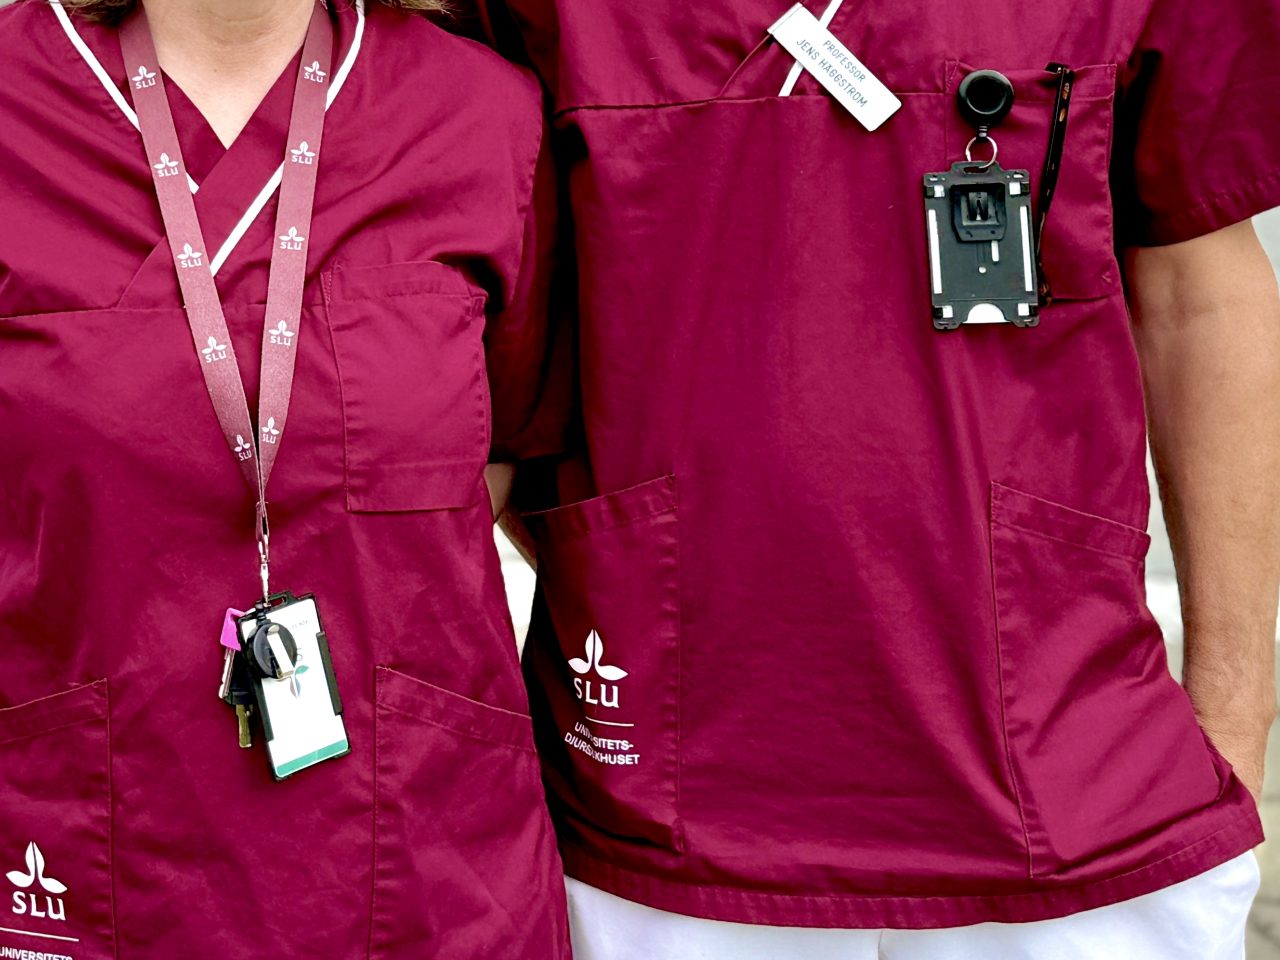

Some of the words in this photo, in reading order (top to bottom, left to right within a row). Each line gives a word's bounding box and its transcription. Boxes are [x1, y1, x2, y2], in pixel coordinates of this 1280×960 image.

[796, 39, 820, 60] JENS
[823, 40, 866, 83] PROFESSOR
[304, 71, 324, 83] SLU
[135, 78, 156, 89] SLU
[291, 154, 313, 165] SLU
[157, 167, 179, 178] SLU
[280, 241, 302, 251] SLU
[180, 258, 203, 269] SLU
[270, 335, 292, 347] SLU
[205, 350, 227, 363] SLU
[262, 433, 277, 445] SLU
[238, 450, 253, 461] SLU
[573, 677, 620, 709] SLU
[12, 890, 67, 921] SLU
